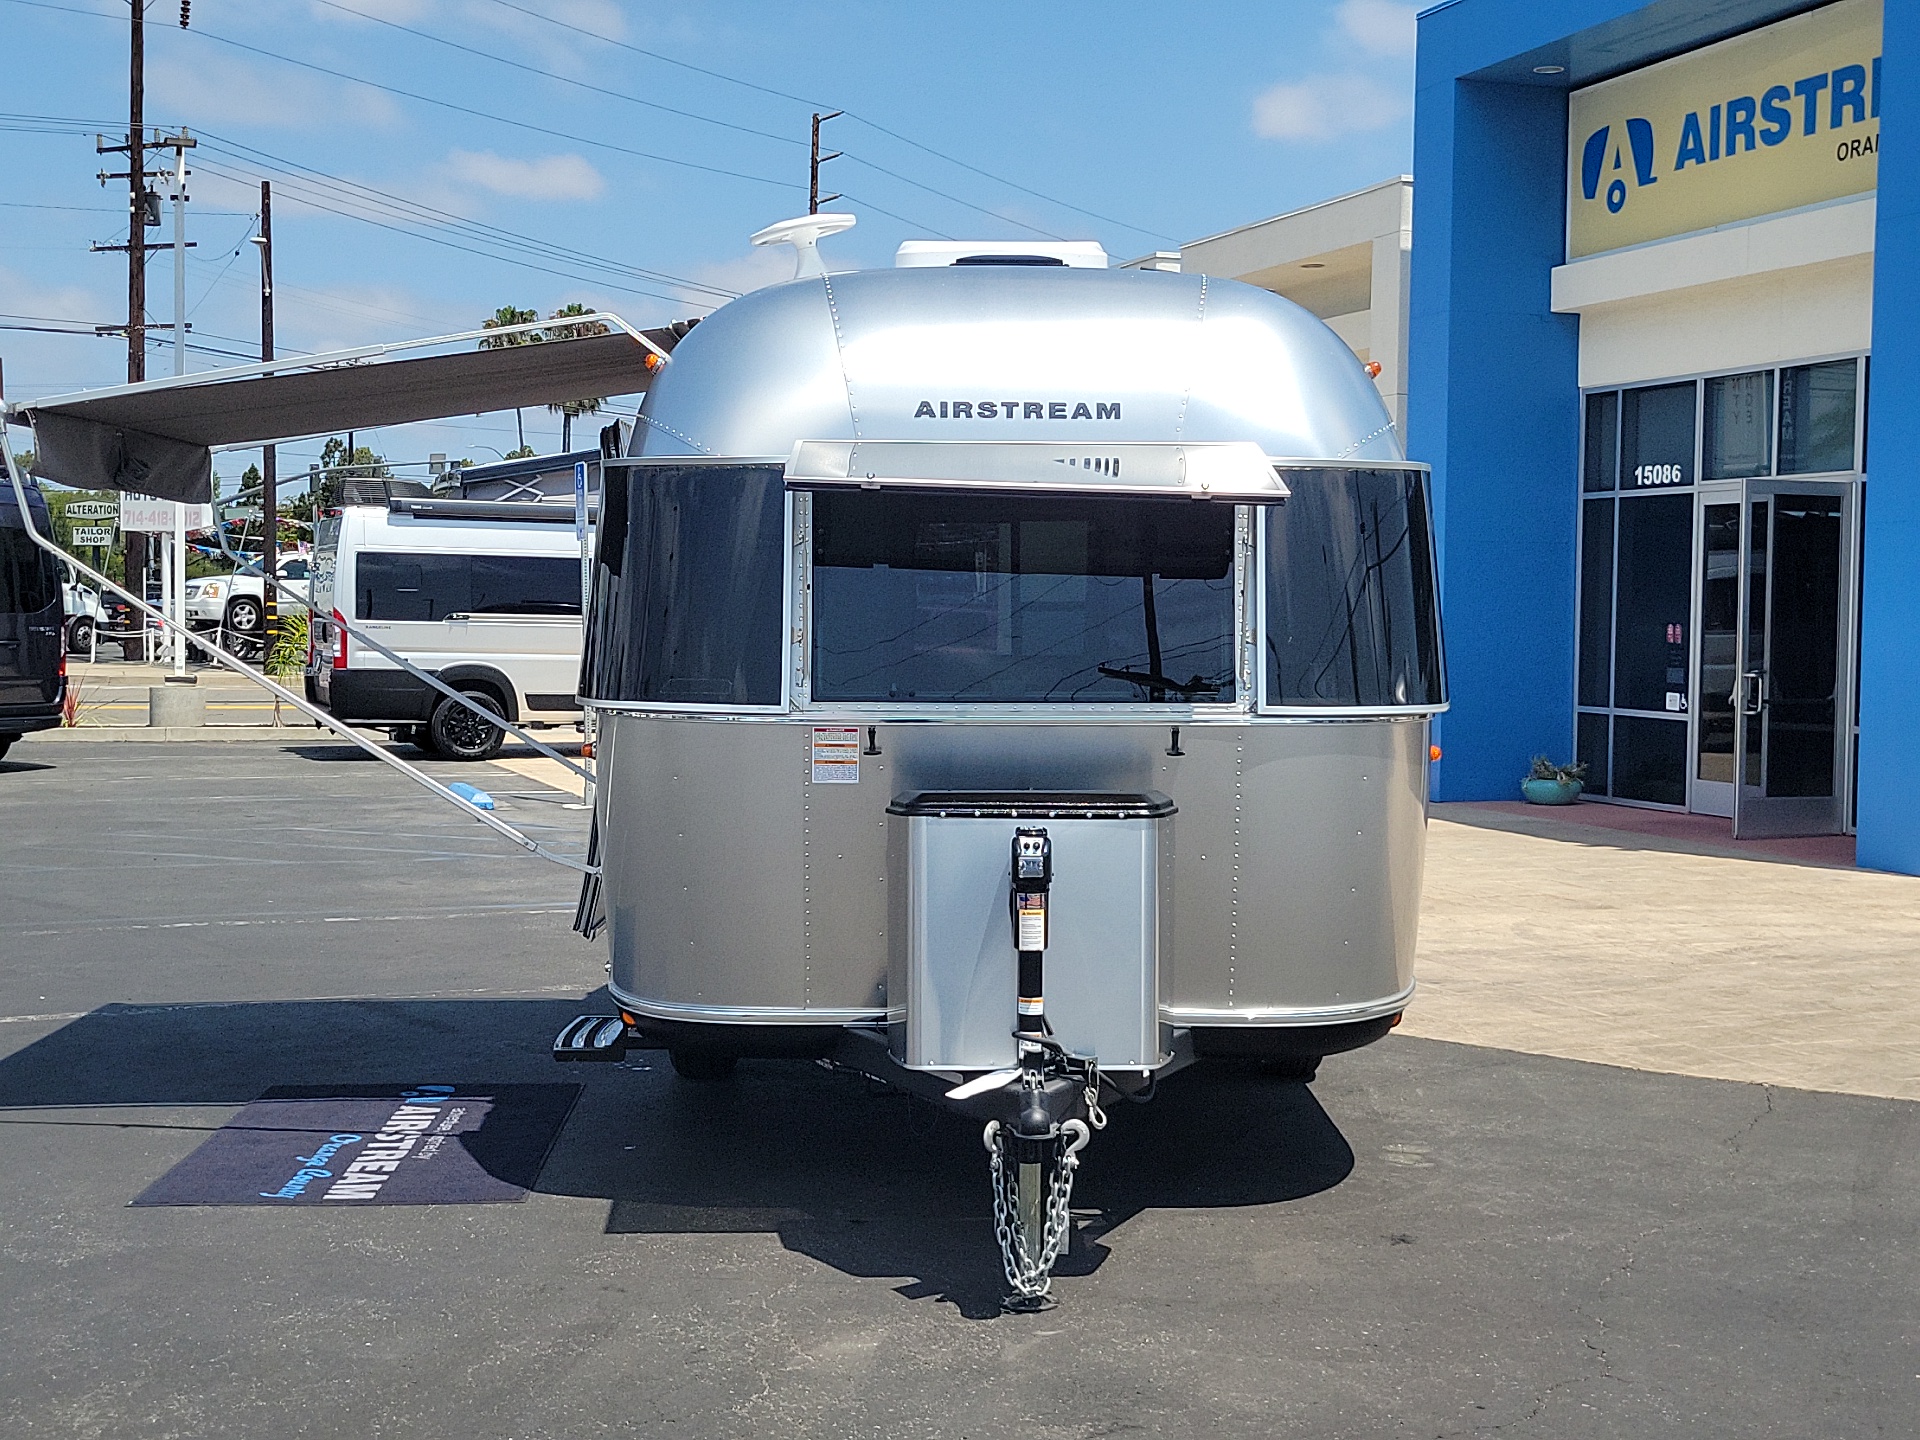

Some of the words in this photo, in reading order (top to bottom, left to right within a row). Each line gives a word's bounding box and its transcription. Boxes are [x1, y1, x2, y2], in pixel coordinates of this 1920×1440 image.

[1837, 133, 1880, 161] ORA
[914, 401, 1121, 420] AIRSTREAM
[1634, 464, 1682, 486] 15086
[66, 504, 119, 515] ALTERATION
[74, 528, 111, 536] TAILOR
[80, 536, 106, 544] SHOP
[295, 1133, 362, 1167] Orange
[322, 1105, 442, 1200] AIRSTREAM
[258, 1168, 333, 1199] County
